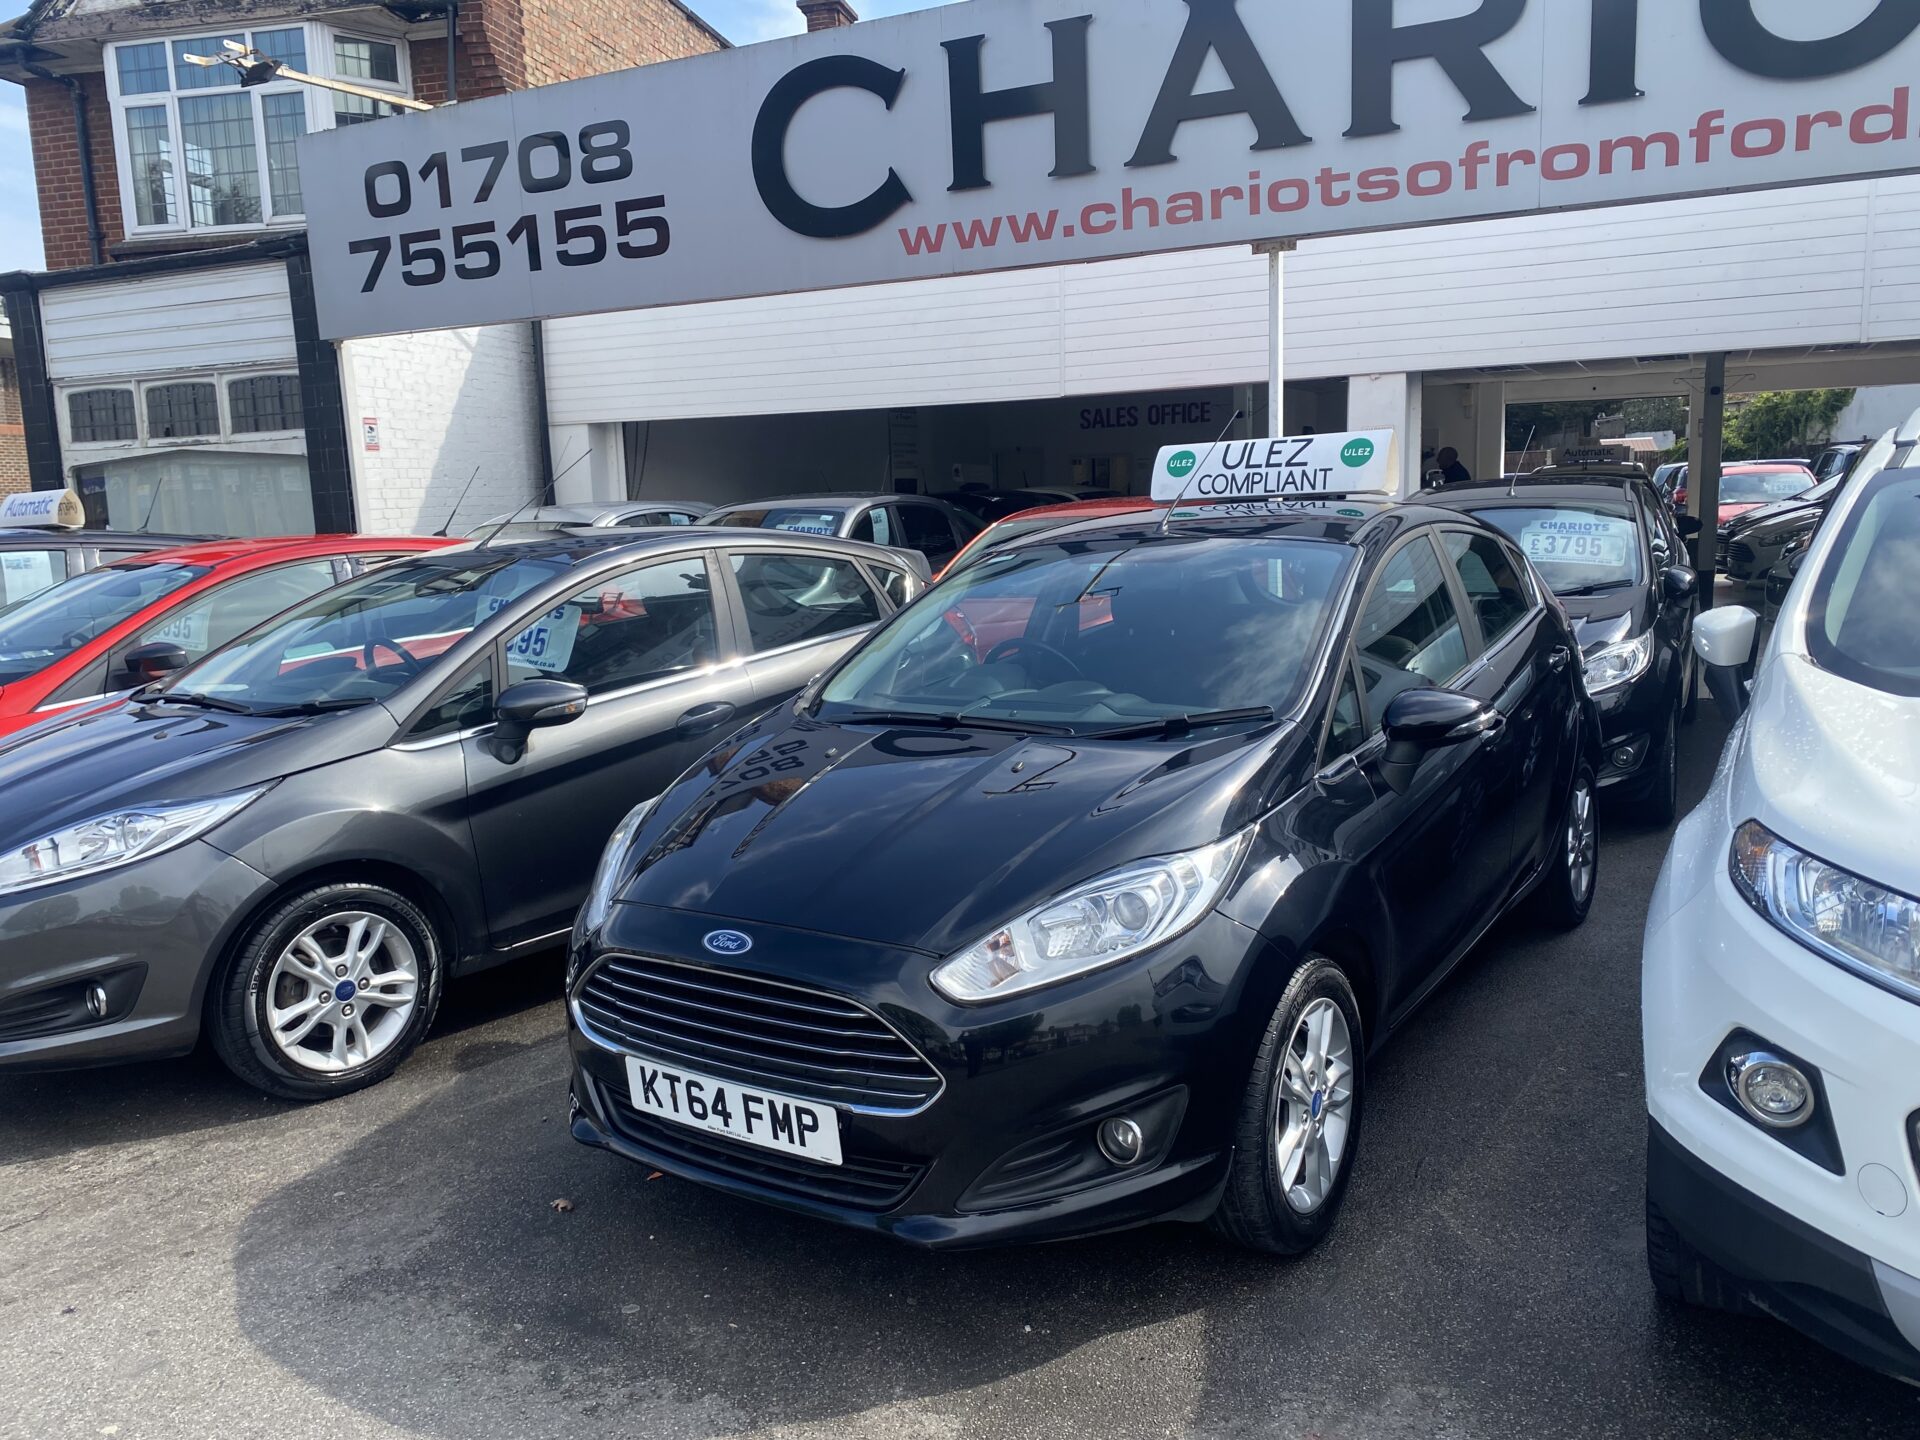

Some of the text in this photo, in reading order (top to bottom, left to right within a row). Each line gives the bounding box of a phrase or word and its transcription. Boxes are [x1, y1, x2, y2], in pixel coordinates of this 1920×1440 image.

[364, 119, 634, 219] 01708
[348, 194, 671, 294] 755155
[1079, 401, 1212, 430] SALES OFFICE
[1169, 458, 1194, 468] ULEZ
[1222, 437, 1314, 470] ULEZ
[1344, 447, 1371, 457] ULEZ
[1563, 447, 1616, 457] Automatic
[1197, 467, 1334, 495] COMPLIANT
[4, 496, 53, 517] Automatic
[1540, 521, 1610, 532] CHARIOTS
[713, 933, 742, 949] Ford
[639, 1065, 820, 1149] KT64 FMP
